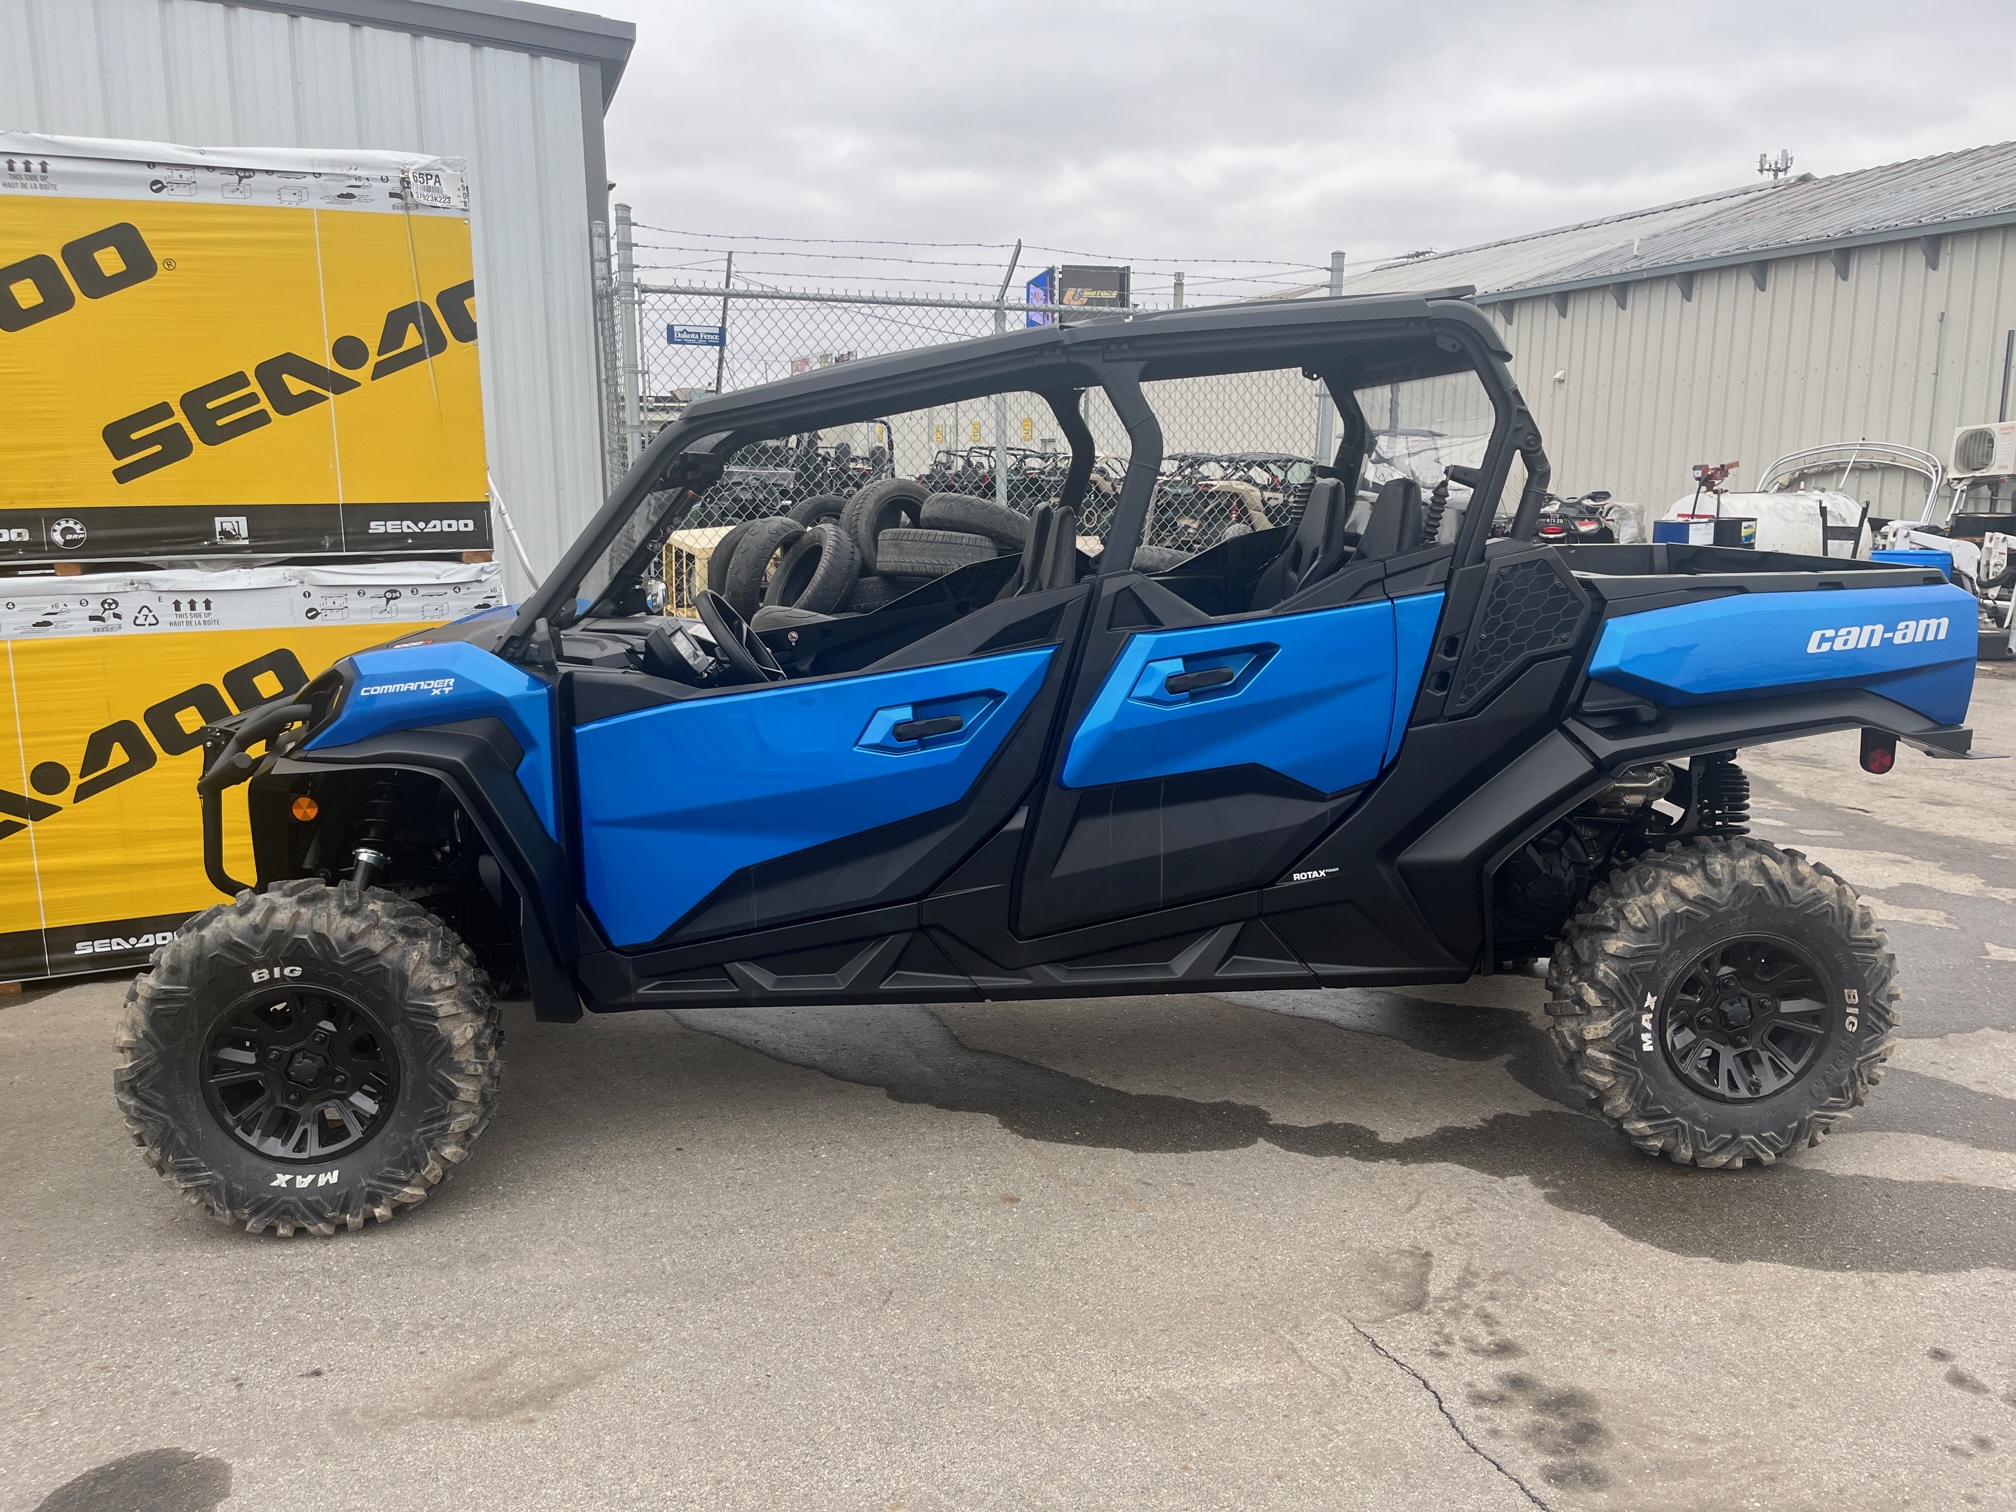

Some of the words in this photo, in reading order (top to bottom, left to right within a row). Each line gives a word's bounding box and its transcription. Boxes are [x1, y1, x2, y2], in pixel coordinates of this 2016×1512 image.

[2, 181, 19, 189] HAUT
[412, 172, 442, 186] 65PA
[674, 331, 699, 339] Dakota
[700, 332, 720, 340] Fence
[1806, 617, 1950, 654] can-am
[360, 678, 455, 696] COMMANDER
[430, 687, 453, 695] XT
[1293, 869, 1327, 881] ROTAX
[251, 966, 303, 984] BIG
[1844, 988, 1859, 1033] BIG
[1642, 991, 1658, 1052] MAX
[269, 1169, 339, 1189] MAX
